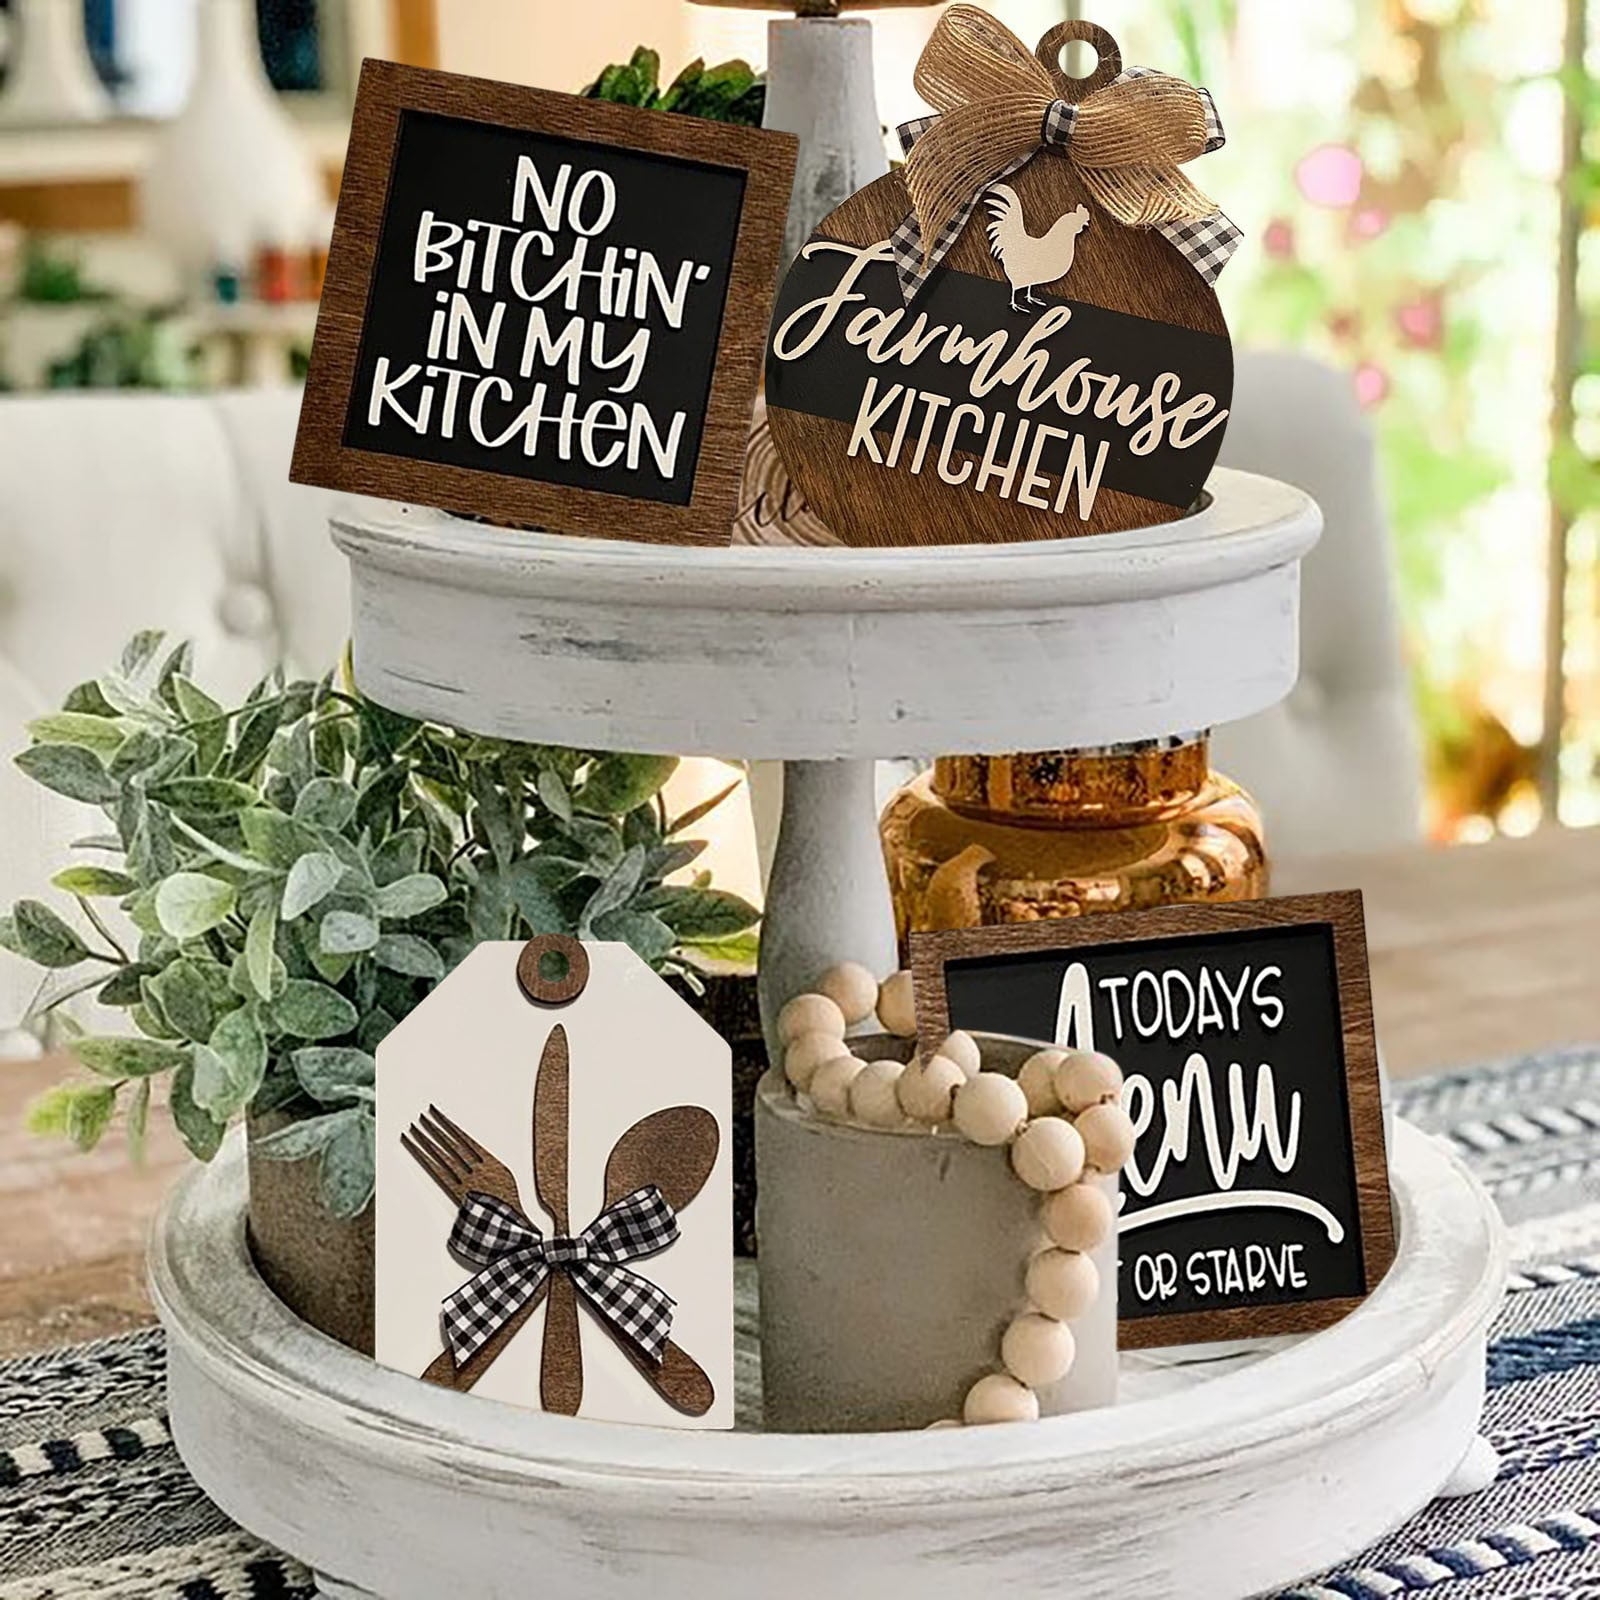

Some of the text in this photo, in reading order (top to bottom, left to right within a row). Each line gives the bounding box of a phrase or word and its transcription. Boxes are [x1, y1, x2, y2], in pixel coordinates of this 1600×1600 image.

[511, 155, 616, 236] NO
[773, 239, 1230, 456] Farmhouse
[846, 376, 1110, 521] KITCHEN
[1098, 965, 1284, 1039] TODAYS
[1134, 1243, 1308, 1301] OR STARVE
